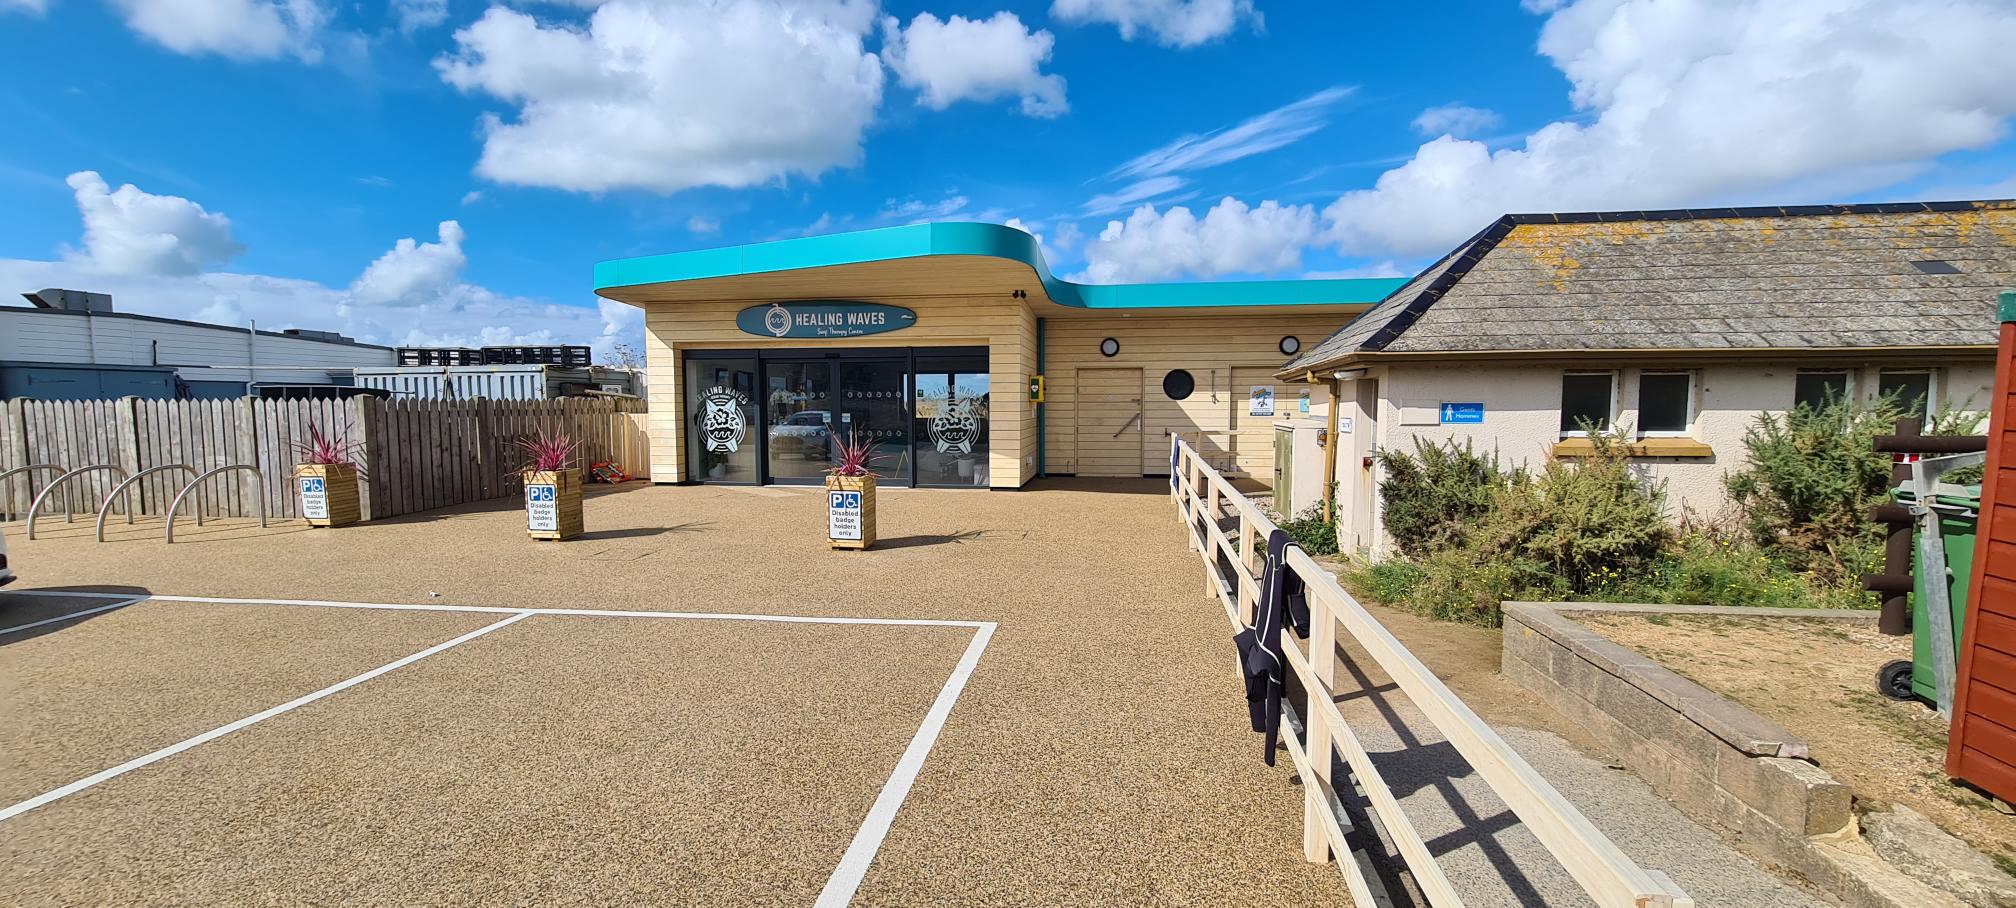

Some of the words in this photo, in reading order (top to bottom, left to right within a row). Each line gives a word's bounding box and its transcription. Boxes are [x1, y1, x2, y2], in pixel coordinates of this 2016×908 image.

[795, 313, 843, 326] HEALING
[847, 312, 885, 325] WAVES
[817, 327, 828, 337] Surf
[829, 327, 848, 337] Therapy
[848, 327, 864, 335] Centre
[696, 385, 723, 402] EALING
[725, 386, 749, 405] WAVES
[832, 494, 843, 507] P
[831, 509, 859, 517] Disabled
[835, 516, 855, 524] badge
